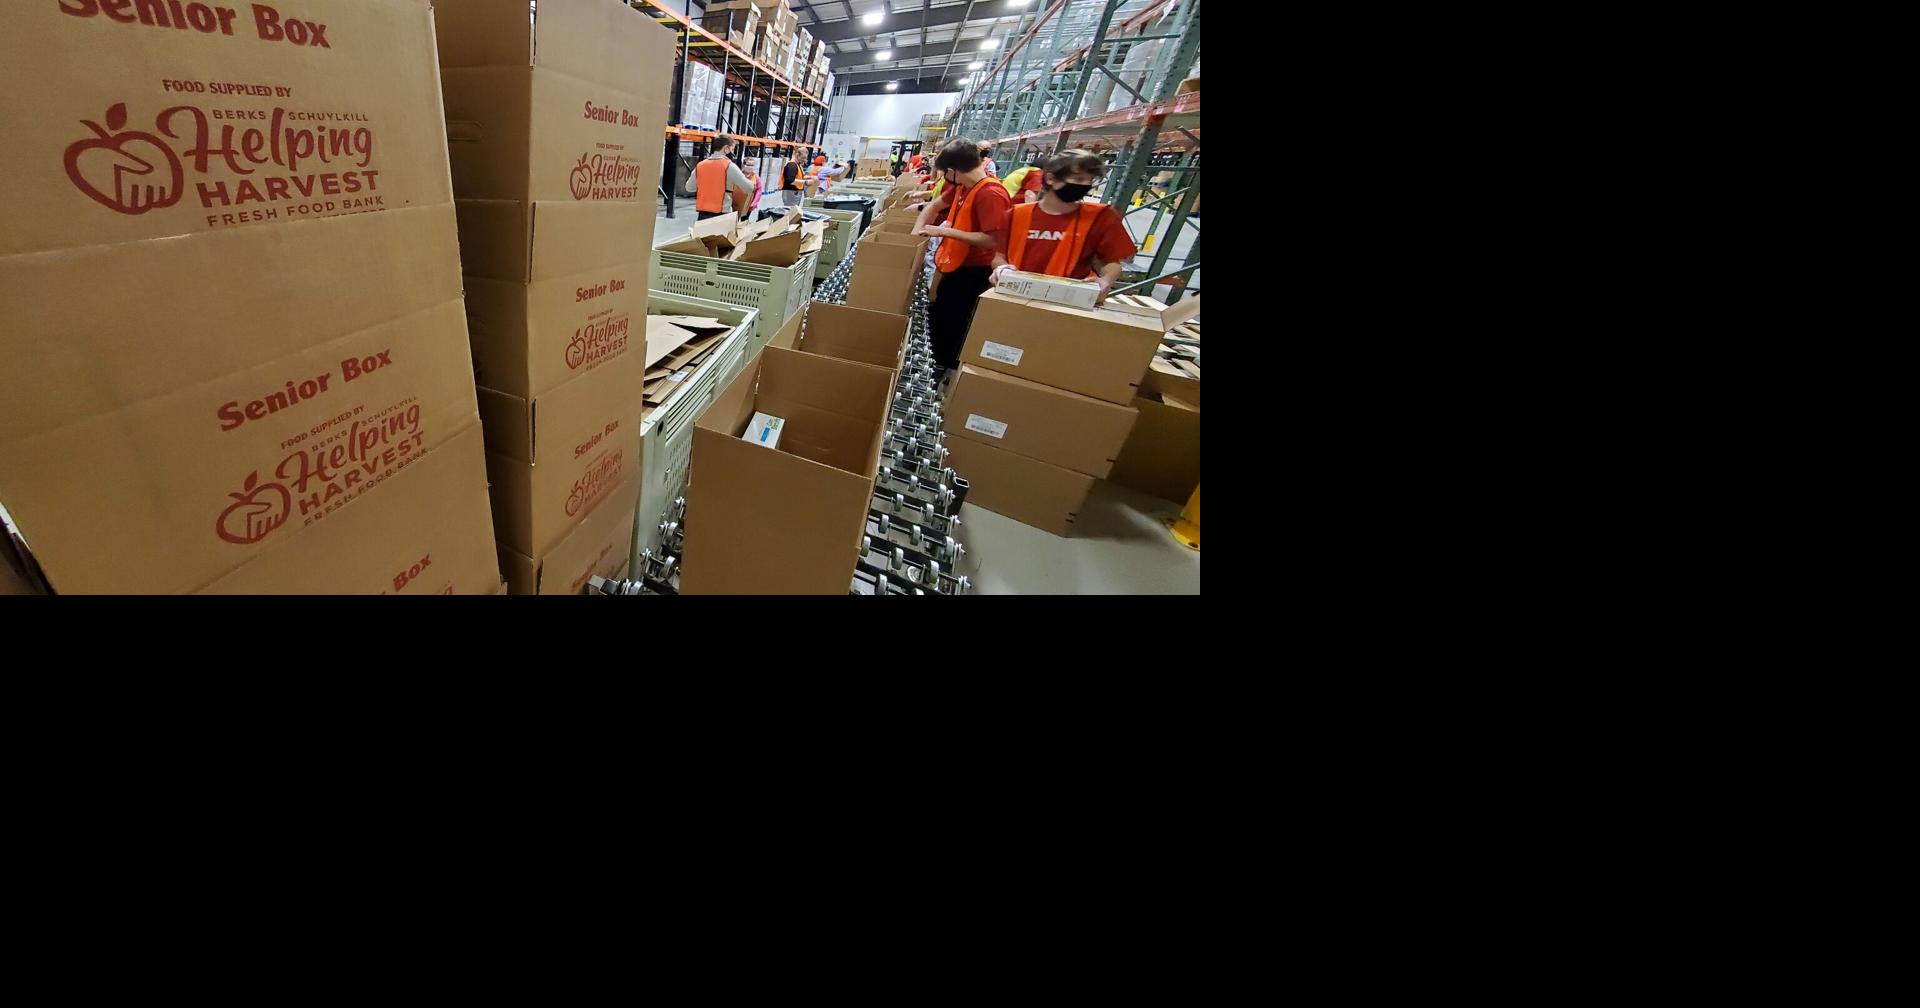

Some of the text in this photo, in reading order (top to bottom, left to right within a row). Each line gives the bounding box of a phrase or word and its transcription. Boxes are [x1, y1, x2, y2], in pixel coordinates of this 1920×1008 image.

[252, 2, 331, 49] Box
[162, 79, 292, 98] FOOD SUPPLIED BY
[212, 108, 369, 122] BERKS SCHUYLKILL
[584, 101, 639, 127] Senior Box
[155, 105, 373, 175] Helping
[591, 153, 640, 186] Helping
[195, 170, 380, 208] HARVEST
[592, 186, 638, 200] HARVEST
[207, 208, 278, 228] FRESH
[286, 201, 336, 217] FOOD
[342, 195, 384, 210] BANK
[1026, 229, 1067, 241] IAN
[576, 280, 625, 302] Senior Box
[584, 317, 628, 350] Helping
[586, 334, 628, 364] HARVEST
[217, 349, 393, 432] Senior Box
[280, 404, 366, 450] FOOD SUPPLIED BY
[275, 404, 420, 493] Helping
[298, 430, 425, 516] HARVEST
[392, 553, 432, 593] Box
